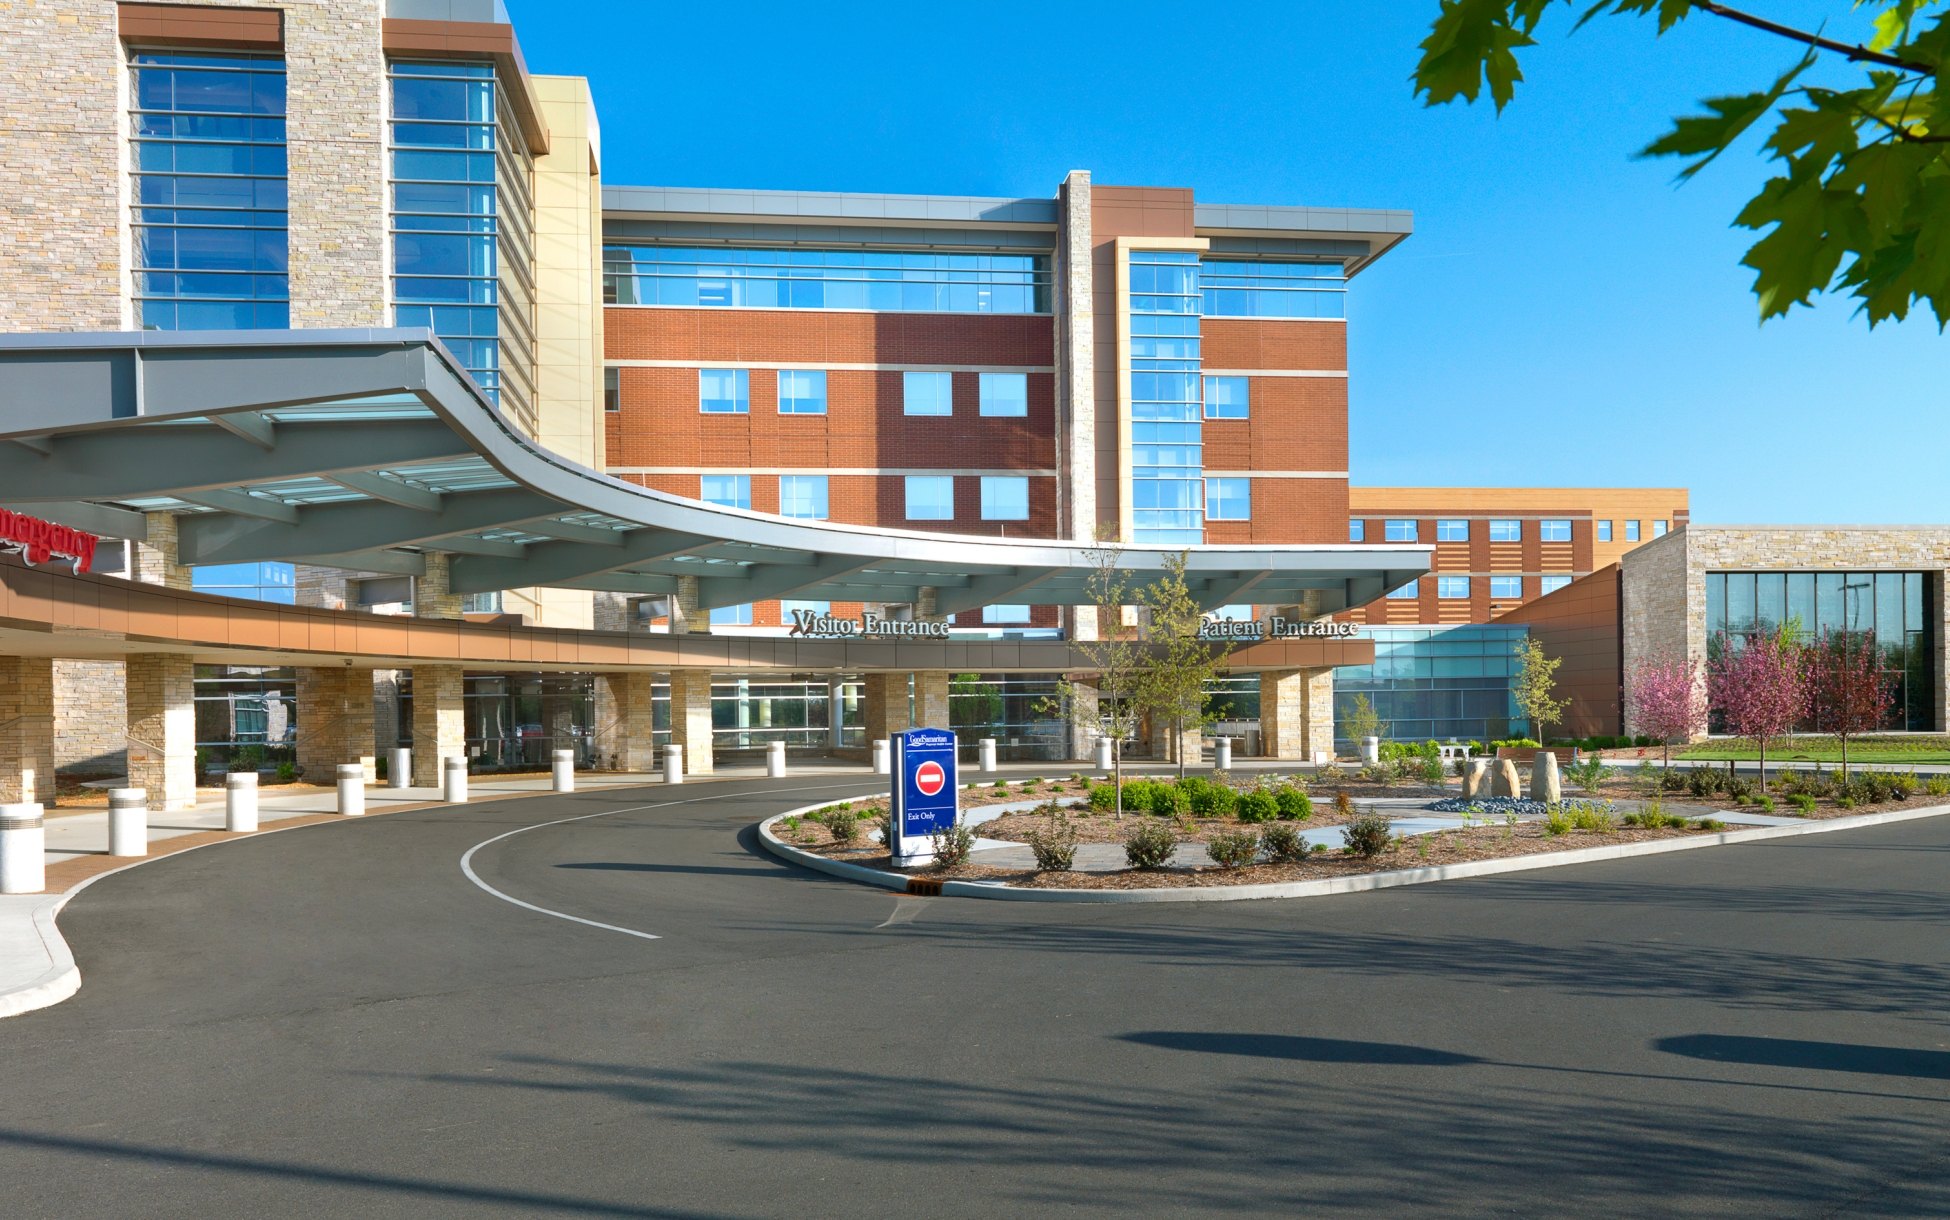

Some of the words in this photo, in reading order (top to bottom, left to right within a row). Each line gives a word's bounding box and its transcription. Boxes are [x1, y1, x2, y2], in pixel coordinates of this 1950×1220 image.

[793, 609, 859, 635] Visitor
[862, 612, 950, 636] Entrance
[1198, 616, 1264, 637] Patient
[1271, 616, 1360, 637] Entrance
[907, 812, 920, 821] Exit
[920, 811, 936, 821] Only
